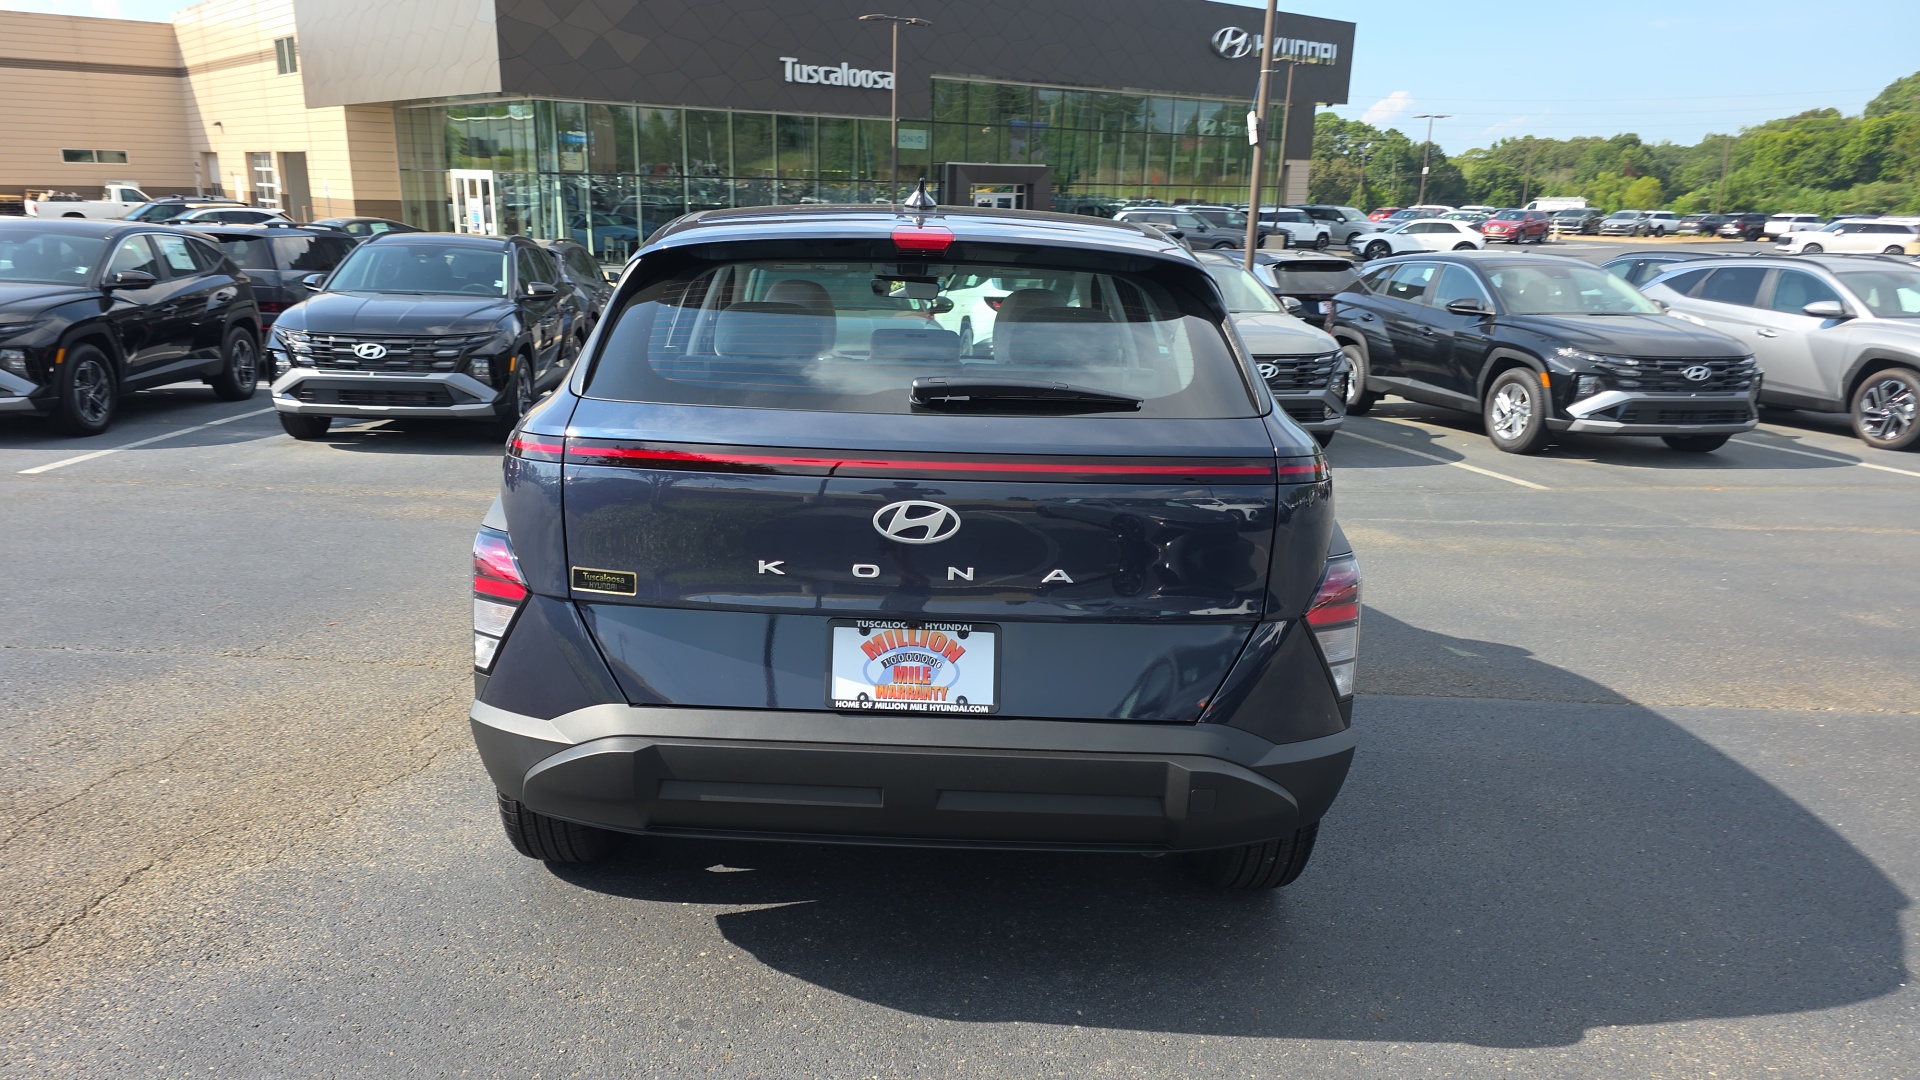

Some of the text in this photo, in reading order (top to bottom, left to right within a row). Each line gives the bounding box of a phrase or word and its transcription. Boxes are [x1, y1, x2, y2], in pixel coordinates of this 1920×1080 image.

[779, 56, 895, 90] Tuscaloosa
[582, 571, 625, 584] Tuscaloosa
[758, 560, 1074, 584] KONA
[588, 581, 618, 590] HYUNDAI
[856, 620, 972, 631] TUSCALOO HYUNDAI
[860, 629, 966, 664] MILLION
[893, 665, 931, 685] MILE
[875, 684, 949, 701] WARRANTY
[835, 700, 989, 713] HOME OF MILLION MILE HYUNDAI.COM
